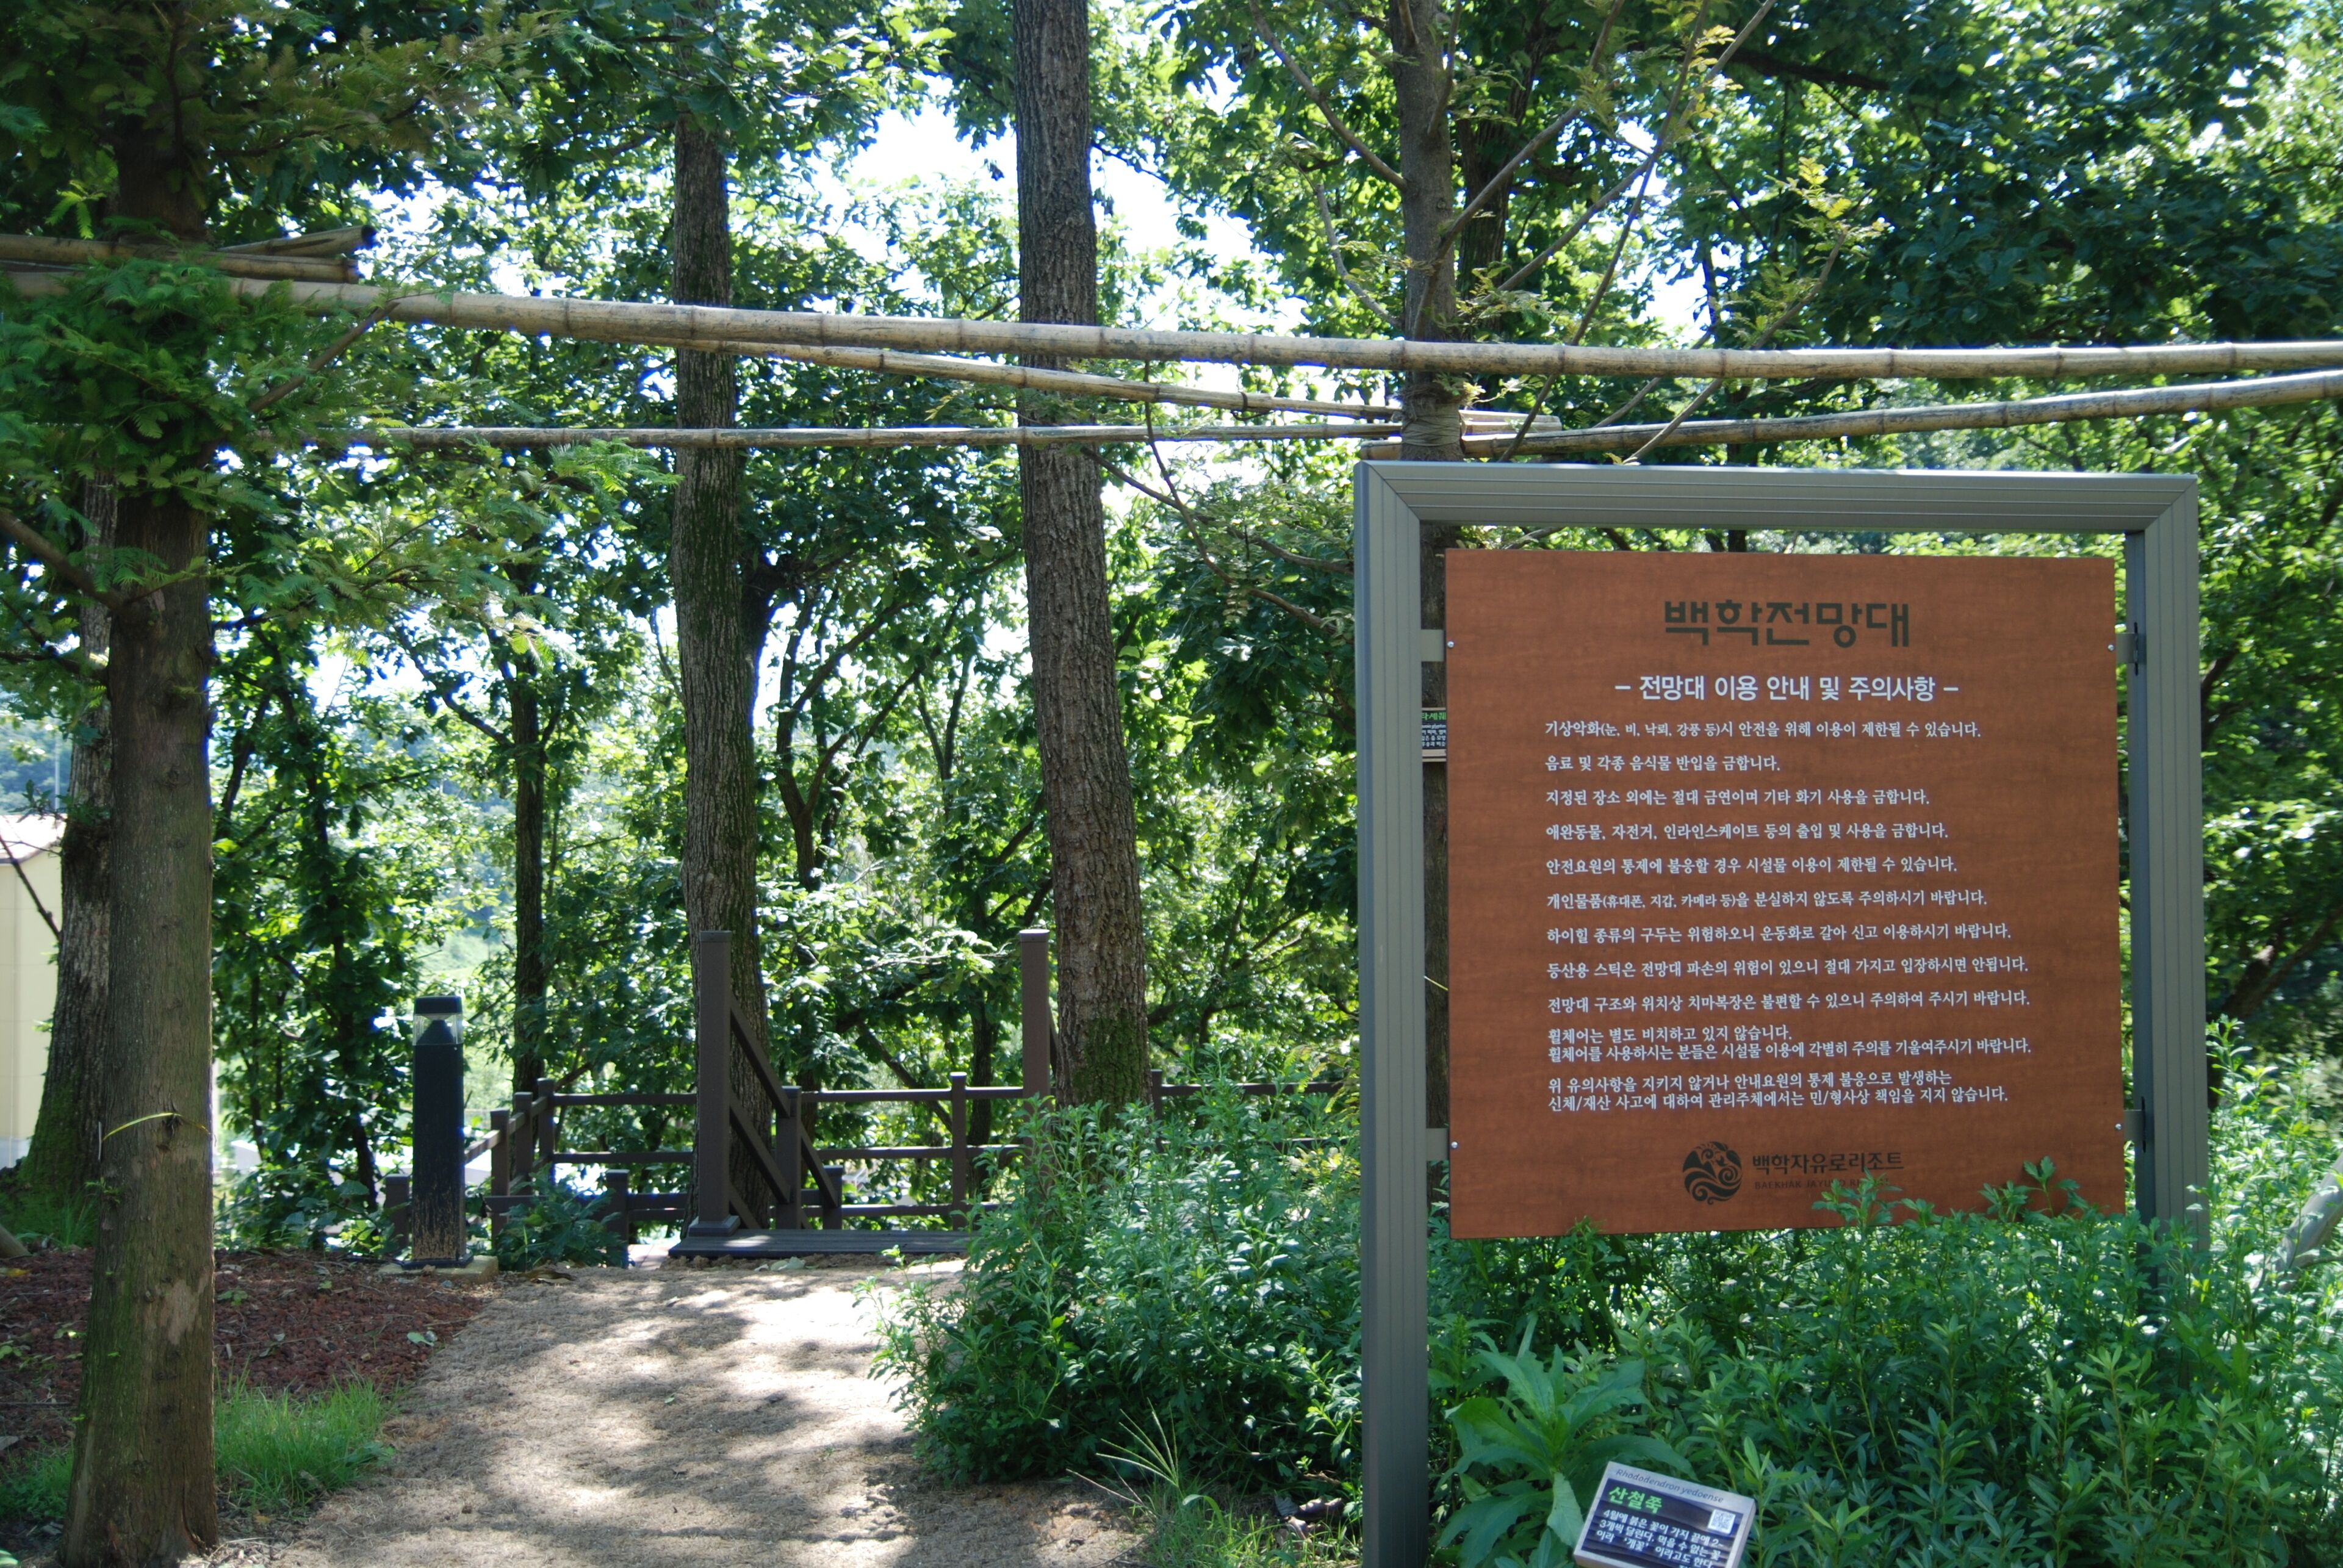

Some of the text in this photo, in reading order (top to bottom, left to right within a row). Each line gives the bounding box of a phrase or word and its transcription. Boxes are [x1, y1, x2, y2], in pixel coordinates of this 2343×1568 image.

[1664, 599, 1910, 648] 백학전망대
[1639, 675, 1705, 701] 전망대
[1715, 675, 1758, 701] 이용
[1766, 676, 1810, 701] 안내
[1819, 676, 1839, 701] 및
[1848, 676, 1936, 702] 주의사항
[1677, 723, 1701, 736] 강풍
[1739, 721, 1779, 737] 안전을
[1785, 721, 1810, 737] 위해
[1816, 722, 1855, 737] 이용이
[1862, 722, 1901, 737] 제한될
[1906, 722, 1920, 737] 수
[1925, 722, 1981, 737] 있습니다.
[1545, 755, 1780, 771] 음료 및 각종 음식물 반입을 금합니다.
[1546, 789, 1929, 806] 지정된 장소 외에는 절대 금연이며 기타 화기 사용을 금합니다.
[1664, 824, 1759, 839] 인라인스케이트
[1764, 823, 1790, 839] 등의
[1796, 823, 1822, 839] 출입
[1829, 823, 1840, 838] 및
[1846, 823, 1887, 838] 사용을
[1891, 822, 1948, 838] 금합니다.
[1546, 856, 1957, 874] 안전요원의 통제에 불응할 경우 시설물 이용이 제한될 수 있습니다.
[1682, 894, 1717, 908] 카메라
[1754, 891, 1807, 907] 분실하지
[1813, 891, 1854, 907] 않도록
[1859, 890, 1924, 906] 주의하시기
[1931, 890, 1987, 905] 바랍니다.
[1547, 923, 2010, 944] 하이힐 종류의 구두는 위험하오니 운동화로 갈아 신고 이용하시기 바랍니다.
[1547, 956, 2028, 979] 등산용 스틱은 전망대 파손의 위험이 있으니 절대 가지고 입장하시면 안됩니다.
[1548, 990, 2029, 1013] 전망대 구조와 위치상 치마복장은 불편할 수 있으니 주의하여 주시기 바랍니다.
[1548, 1024, 1791, 1044] 휠체어는 별도 비치하고 있지 않습니다.
[1548, 1038, 2031, 1063] 휠체어를 사용하시는 분들은 시설물 이용에 각별히 주의를 기울여주시기 바랍니다.
[1549, 1070, 1952, 1093] 위 유의사항을 지키지 않거나 안내요원의 통제 불응으로 발생하는
[1549, 1086, 2007, 1112] 신체/재산 사고에 대하여 관리주체에서는 민/형사상 책임을 지지 않습니다.
[1752, 1152, 1904, 1174] 백학자유로리조트
[1755, 1181, 1801, 1190] BAEKHAK
[1807, 1178, 1846, 1189] JAYUO
[1616, 1469, 1724, 1503] Rhododendron yedoense
[1609, 1486, 1663, 1514] 산철쭉
[1599, 1520, 1624, 1536] 3개씩
[1625, 1525, 1654, 1542] 달린다.
[1658, 1535, 1676, 1549] 먹을
[1679, 1541, 1688, 1551] 수
[1690, 1544, 1709, 1557] 없는
[1603, 1509, 1628, 1523] 4월에
[1650, 1521, 1669, 1534] 꽃이
[1671, 1527, 1690, 1540] 가지
[1691, 1533, 1711, 1546] 끝에
[1597, 1530, 1615, 1543] 이라
[1655, 1546, 1691, 1564] 이라고도
